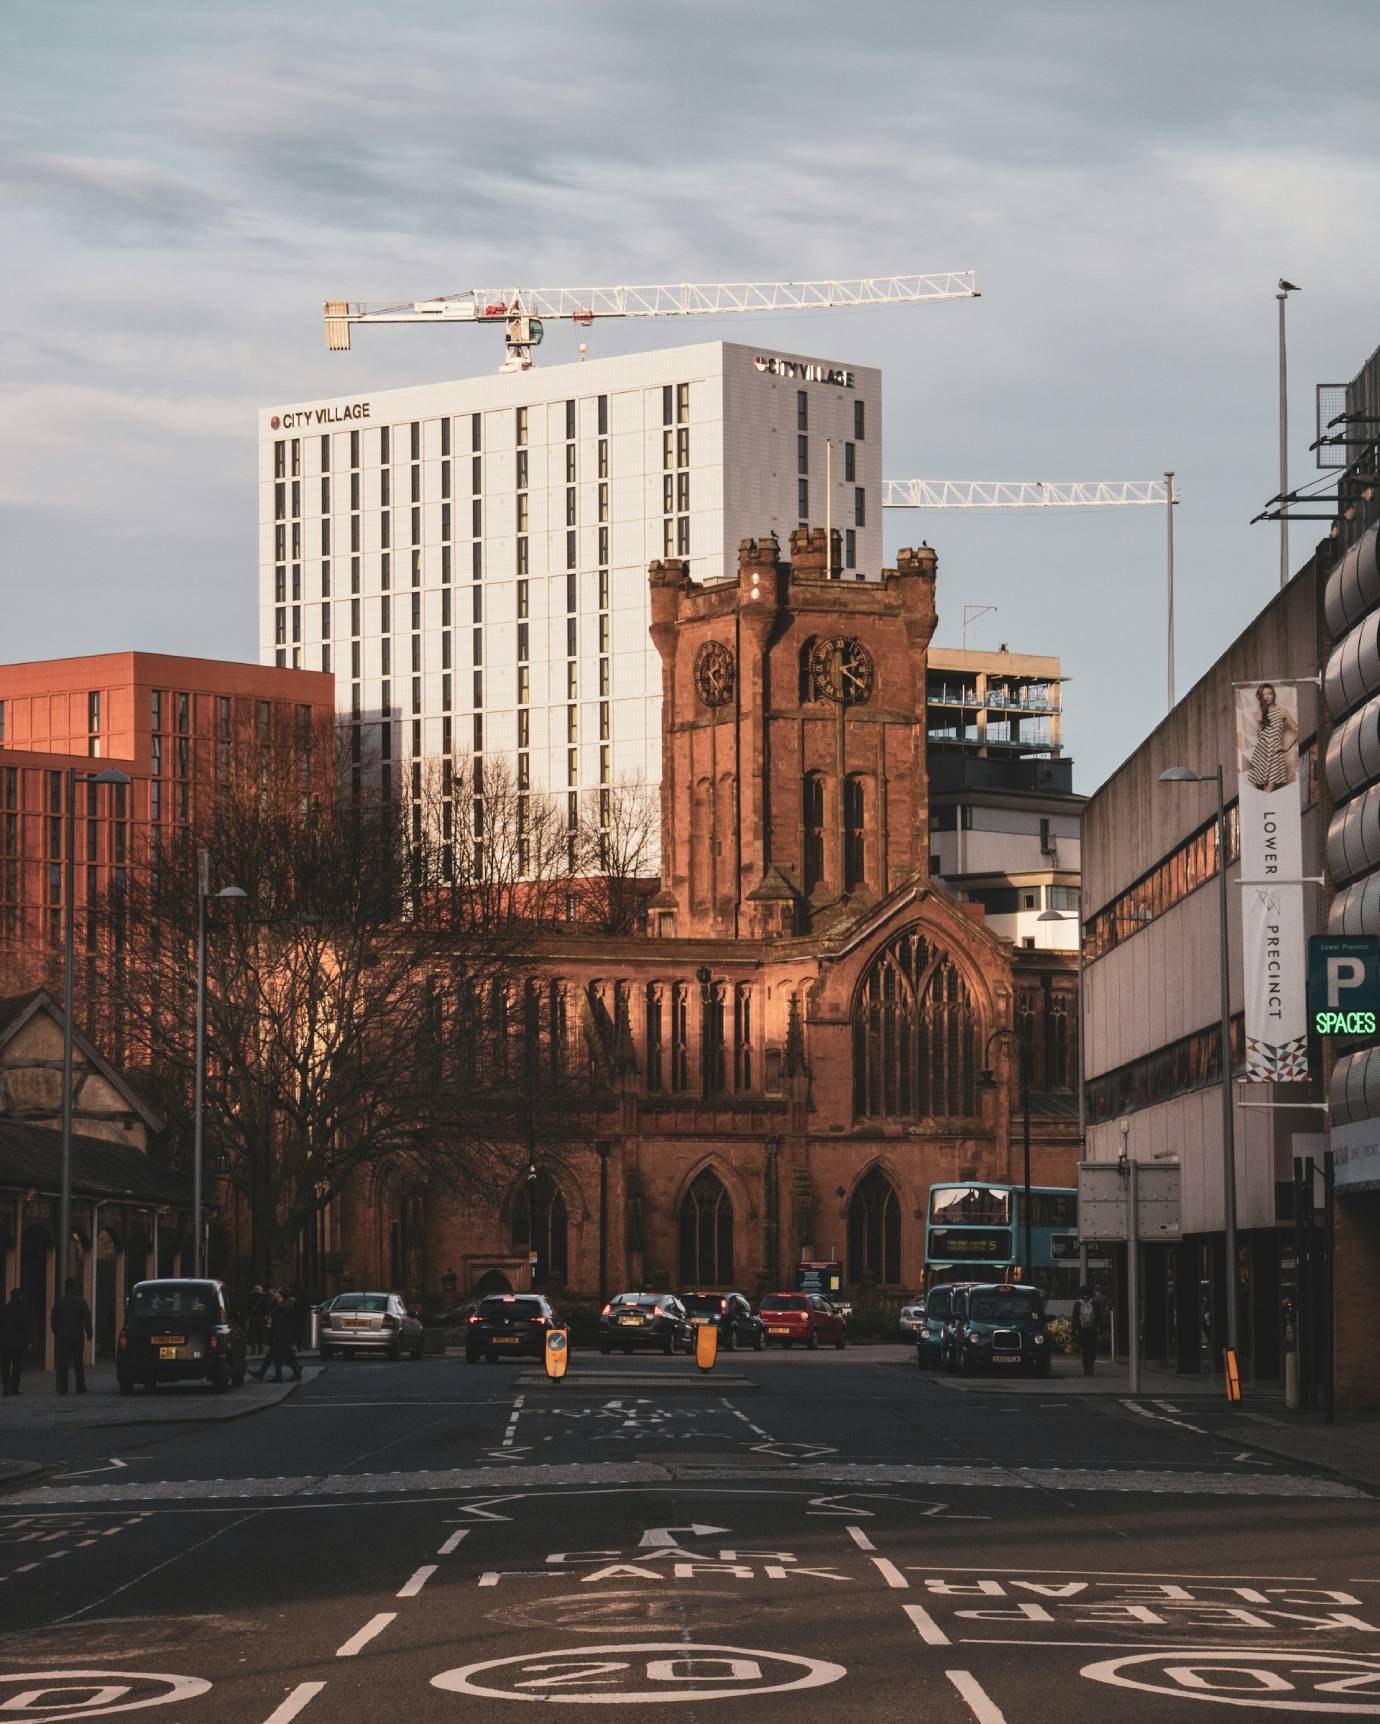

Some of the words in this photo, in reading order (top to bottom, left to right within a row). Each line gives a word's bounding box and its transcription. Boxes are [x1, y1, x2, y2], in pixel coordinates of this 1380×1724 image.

[769, 358, 798, 378] CITY
[800, 363, 855, 388] VILLAGE
[282, 411, 312, 428] CITY
[315, 402, 370, 424] VILLAGE
[1264, 811, 1277, 875] LOWER
[1342, 943, 1369, 951] Precinct
[1266, 925, 1282, 1020] PRECINCT
[1327, 956, 1366, 1008] P
[1316, 1011, 1376, 1034] SPACES
[545, 1547, 798, 1563] CAR
[923, 1579, 1364, 1605] CLEAR
[953, 1603, 1380, 1631] KEEP
[514, 1659, 763, 1687] 20
